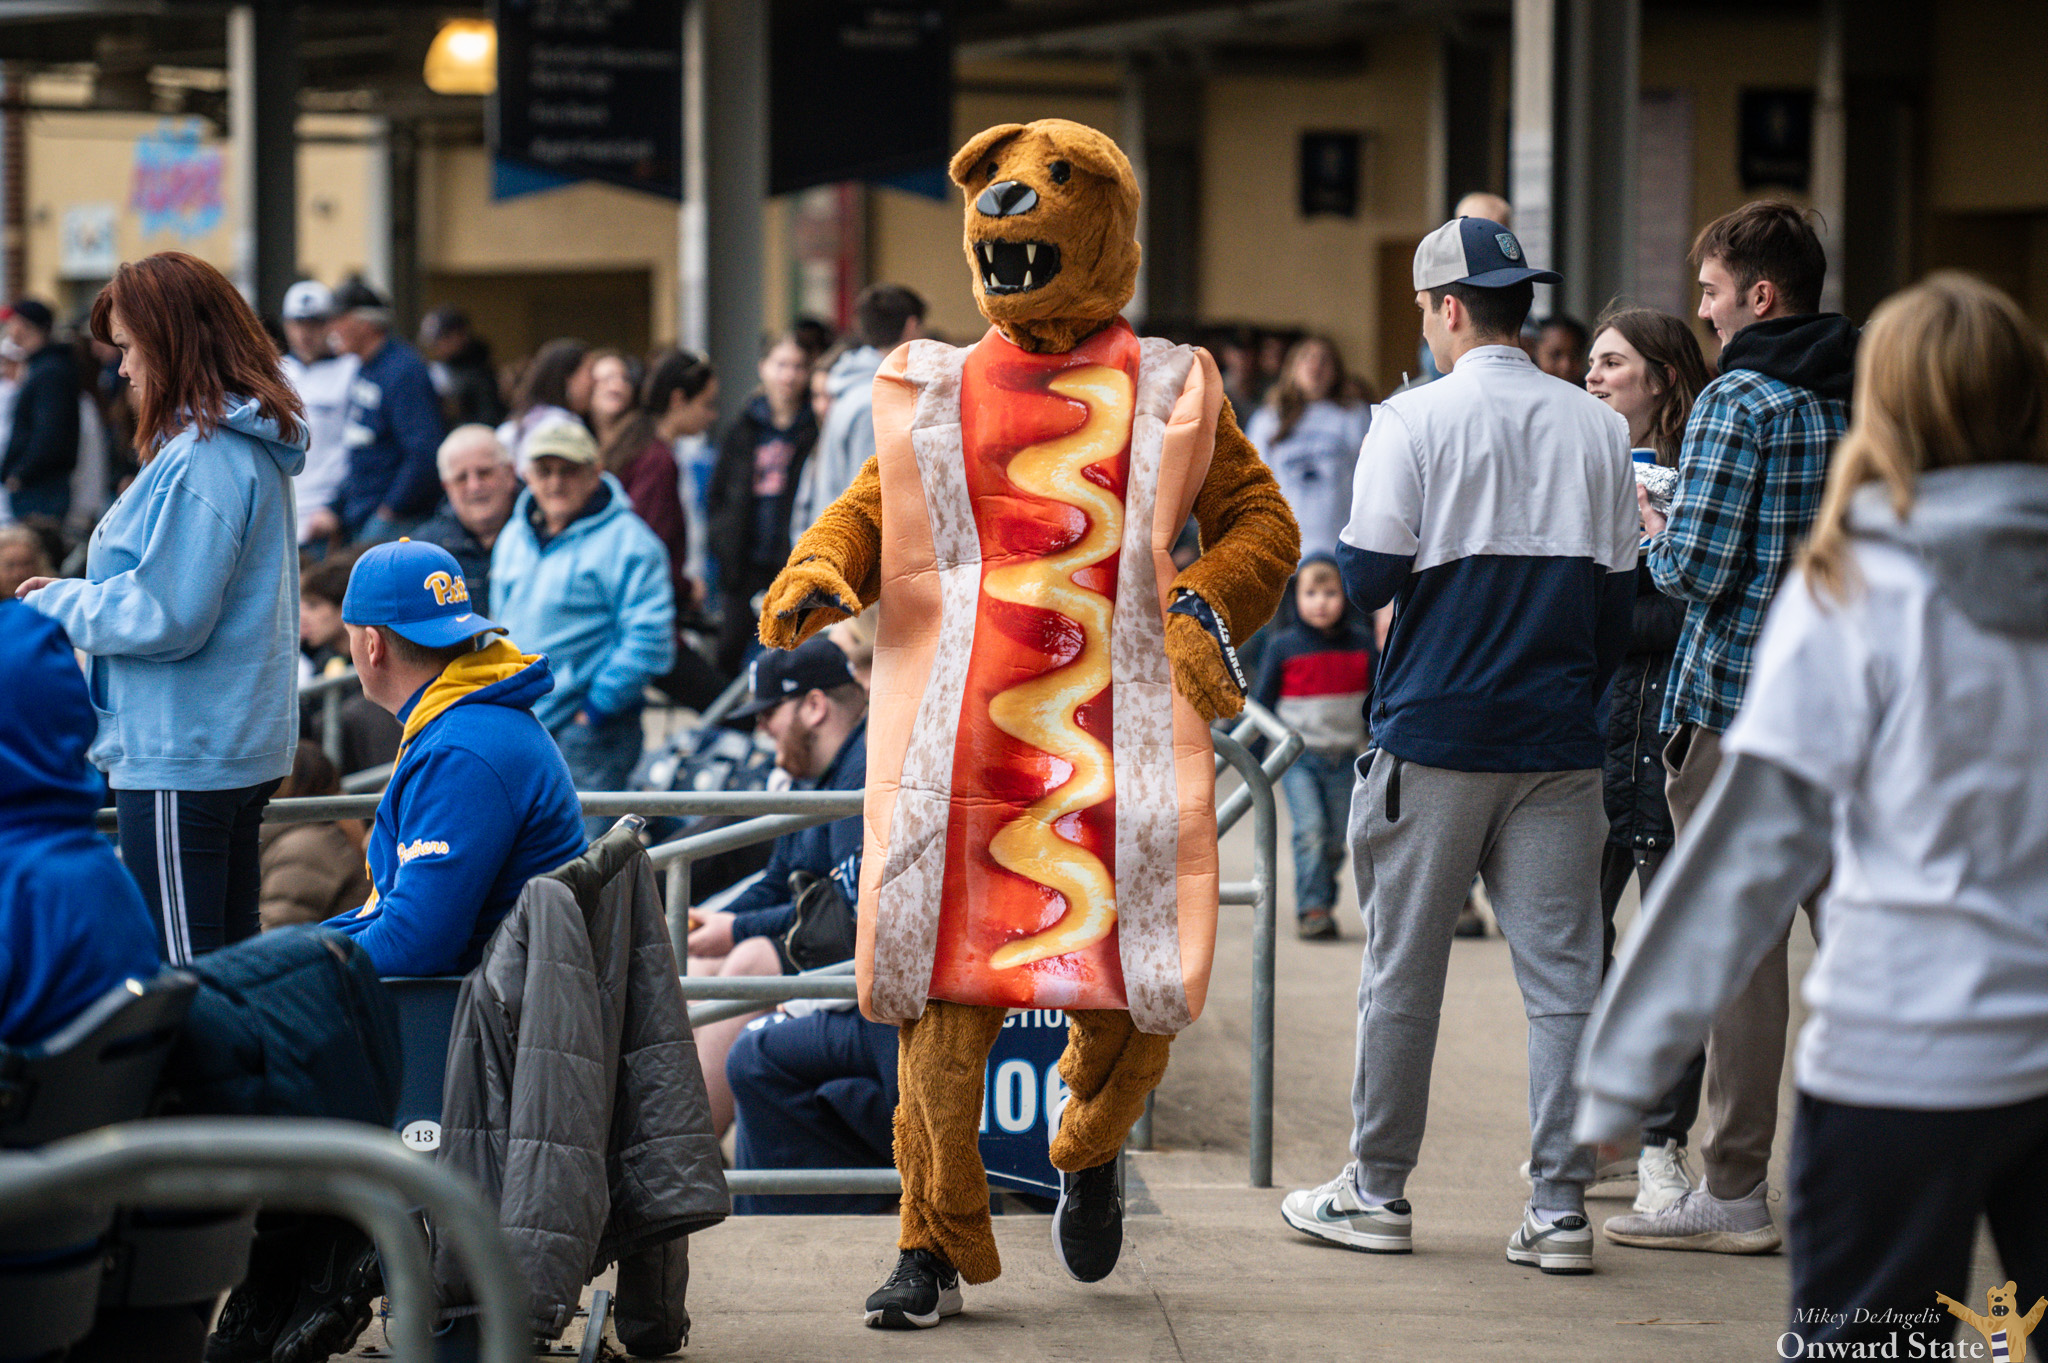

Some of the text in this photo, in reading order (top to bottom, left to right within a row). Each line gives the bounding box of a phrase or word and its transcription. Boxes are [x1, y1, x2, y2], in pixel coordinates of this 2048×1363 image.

[424, 570, 469, 606] Pitt
[397, 838, 450, 867] Panthers
[415, 1129, 434, 1143] 13
[1562, 1216, 1582, 1227] NIKE
